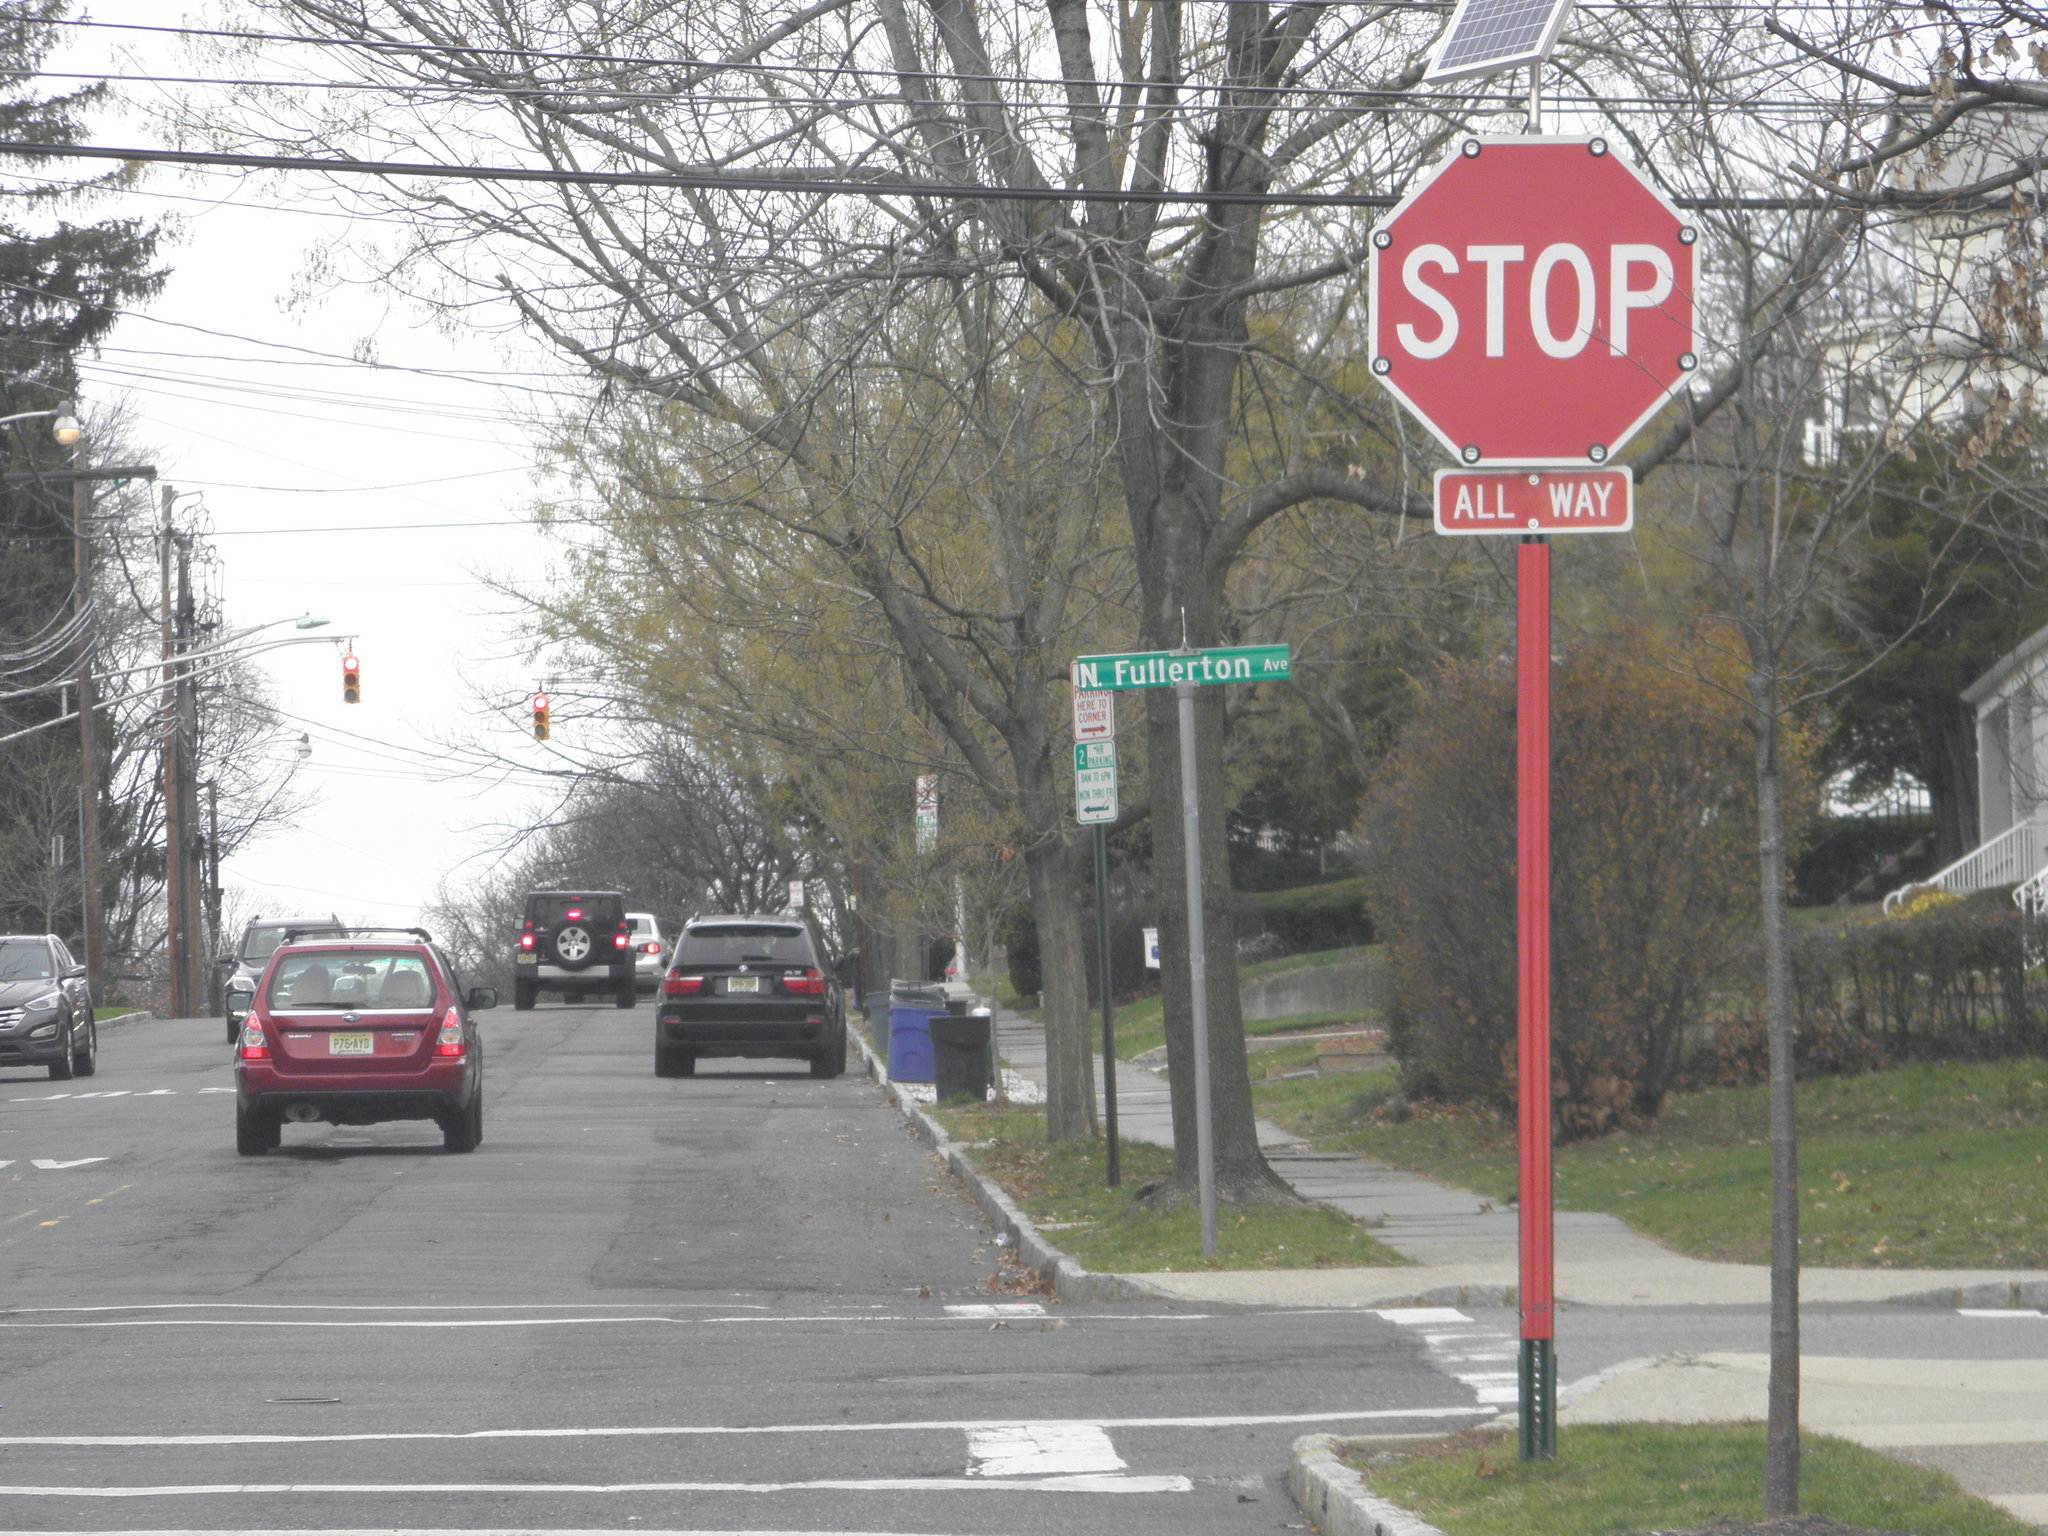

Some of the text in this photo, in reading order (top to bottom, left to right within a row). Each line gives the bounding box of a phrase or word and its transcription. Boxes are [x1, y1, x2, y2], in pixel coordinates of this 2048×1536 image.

[1396, 243, 1674, 360] STOP
[1453, 482, 1613, 520] ALL WAY
[1079, 655, 1288, 688] N. Fullerton Ave
[1077, 699, 1106, 712] HERE TO
[1079, 711, 1106, 723] CORNER
[1078, 749, 1085, 765] 2
[1087, 755, 1112, 767] PARKING
[1093, 771, 1099, 782] TO
